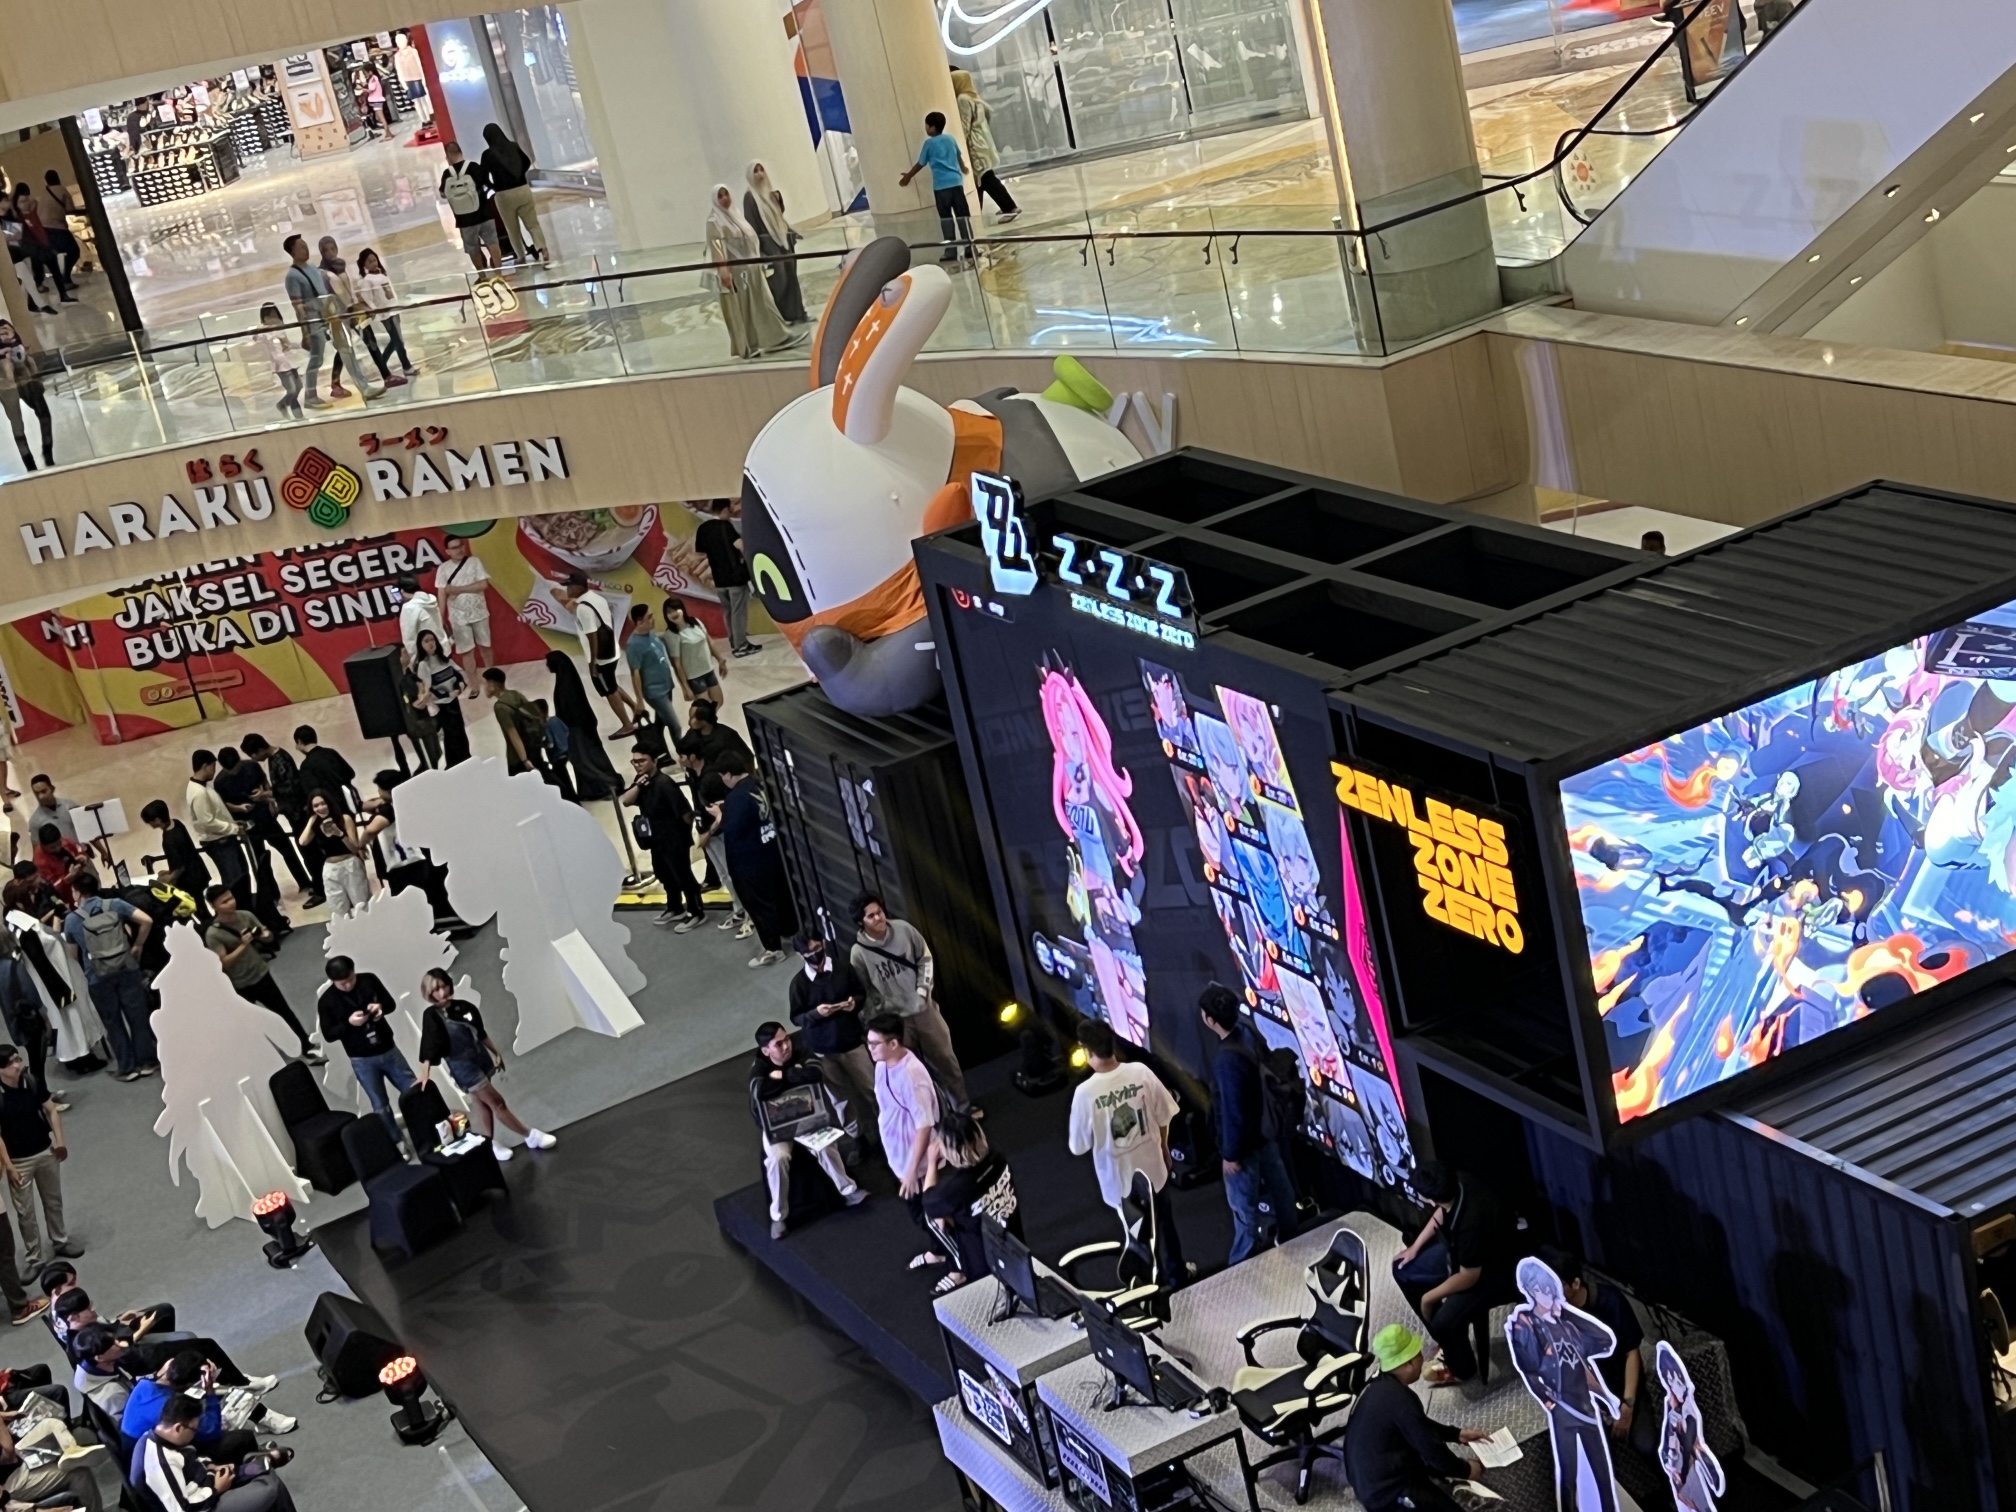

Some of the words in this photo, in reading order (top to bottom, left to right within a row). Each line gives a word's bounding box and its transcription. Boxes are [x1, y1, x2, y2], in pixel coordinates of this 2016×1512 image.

[359, 426, 448, 455] ラーメン
[20, 477, 273, 564] HARAKU
[366, 437, 569, 501] RAMEN
[115, 573, 275, 629] JAKSEL
[280, 538, 442, 593] SEGERA
[124, 617, 245, 667] BUKA
[250, 605, 295, 640] DI
[304, 585, 399, 628] SINI!
[1330, 761, 1509, 866] ZENLESS
[1408, 831, 1518, 914] ZONE
[1418, 874, 1524, 954] ZERO
